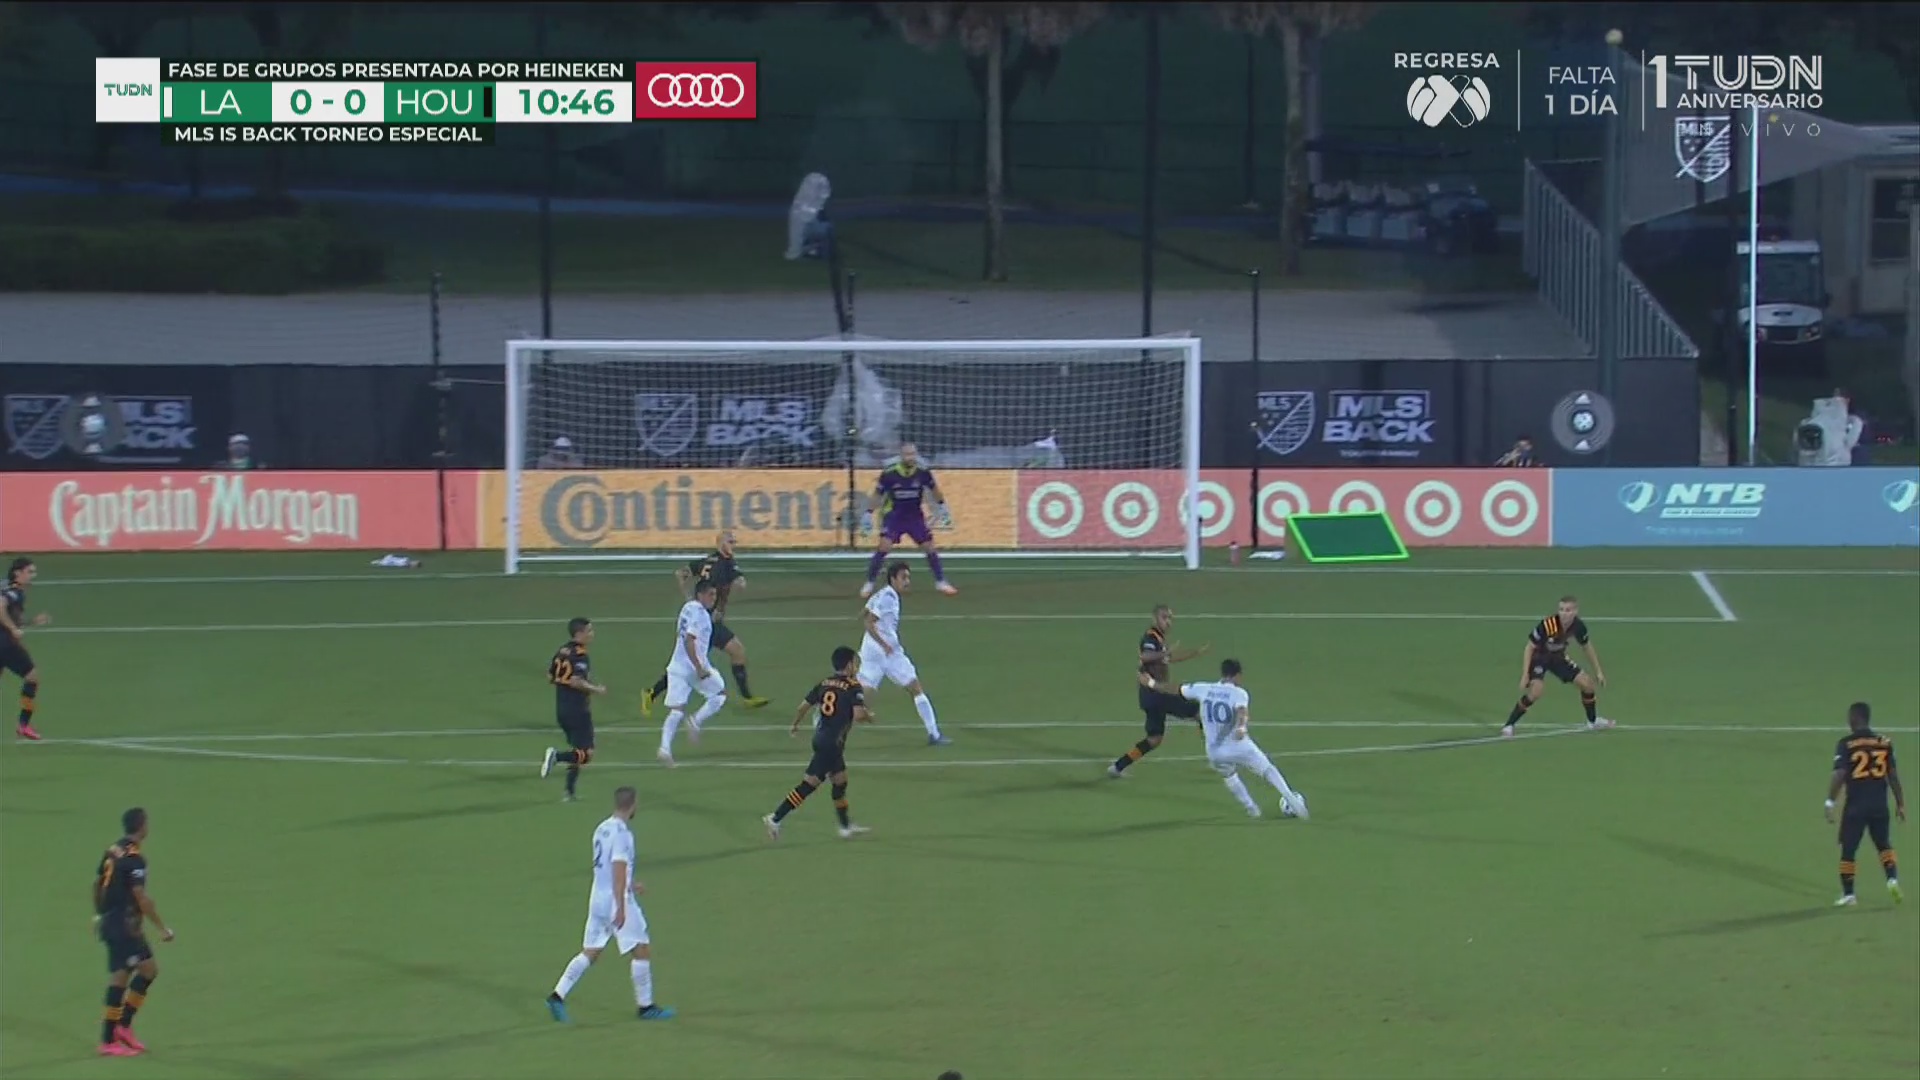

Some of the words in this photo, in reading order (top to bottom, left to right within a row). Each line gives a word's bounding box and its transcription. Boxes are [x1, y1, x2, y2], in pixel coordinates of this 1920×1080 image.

[1336, 395, 1424, 418] MLS
[1322, 420, 1436, 442] BACK
[1664, 483, 1767, 505] NTB
[50, 476, 198, 547] Captain
[195, 474, 359, 549] Morgan
[540, 474, 882, 547] Continenta
[821, 690, 837, 717] 8
[1203, 699, 1233, 724] 10
[1850, 750, 1889, 780] 23
